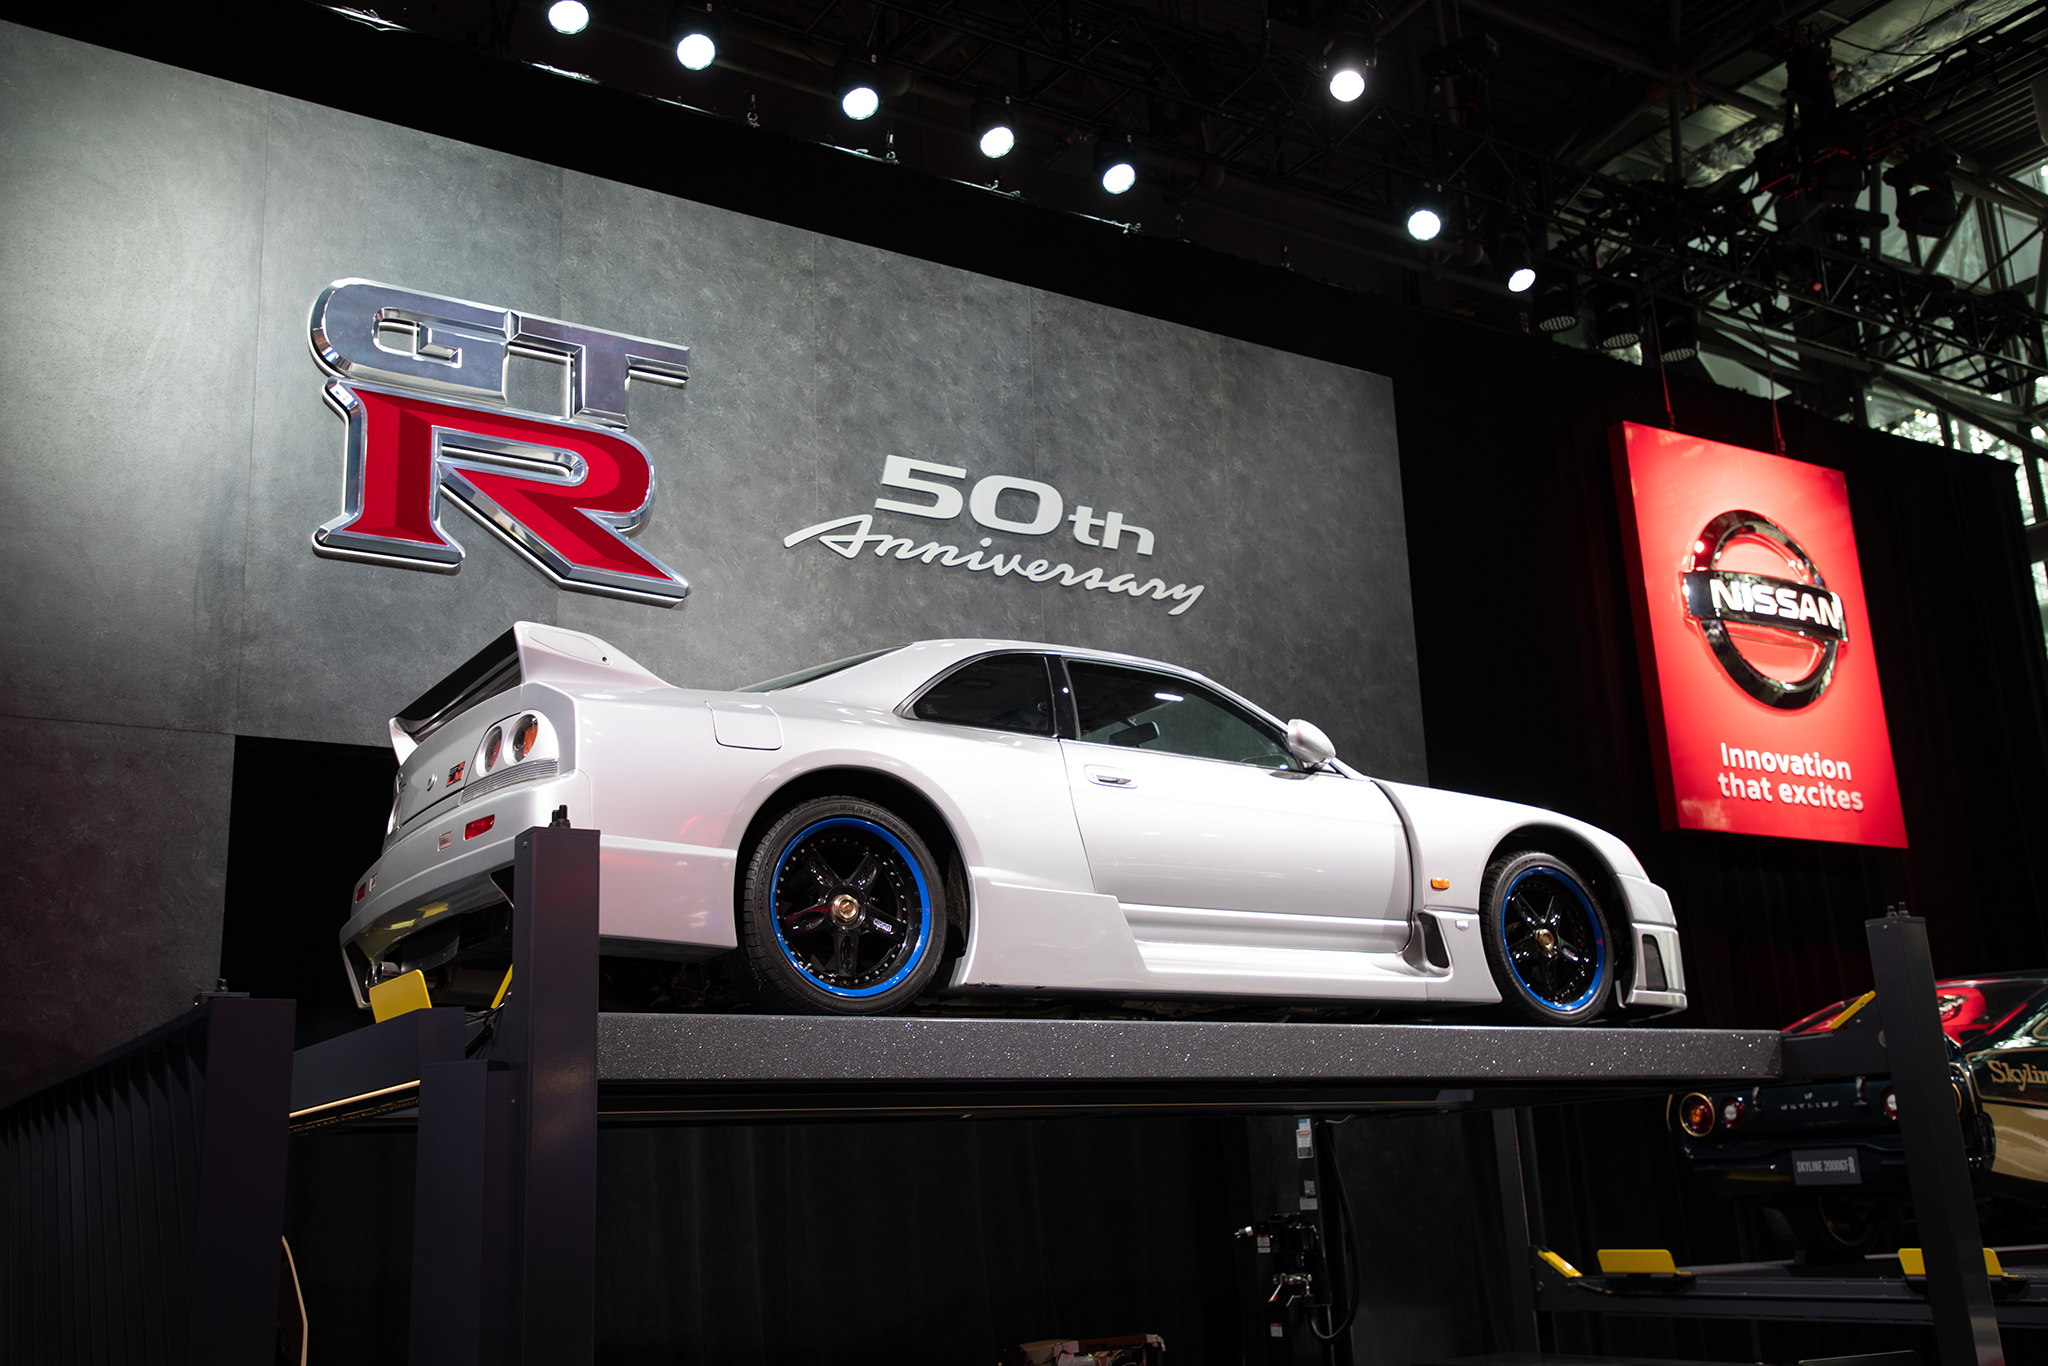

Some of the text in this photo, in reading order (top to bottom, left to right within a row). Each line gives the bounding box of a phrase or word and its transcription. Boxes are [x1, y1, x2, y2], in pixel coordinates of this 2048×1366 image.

[873, 454, 1156, 556] 50th
[783, 514, 1205, 617] Anniversary
[1709, 578, 1842, 631] NISSAN
[1720, 742, 1852, 781] Innovation
[1717, 772, 1864, 811] that excites
[1796, 1160, 1824, 1173] SKYLINE
